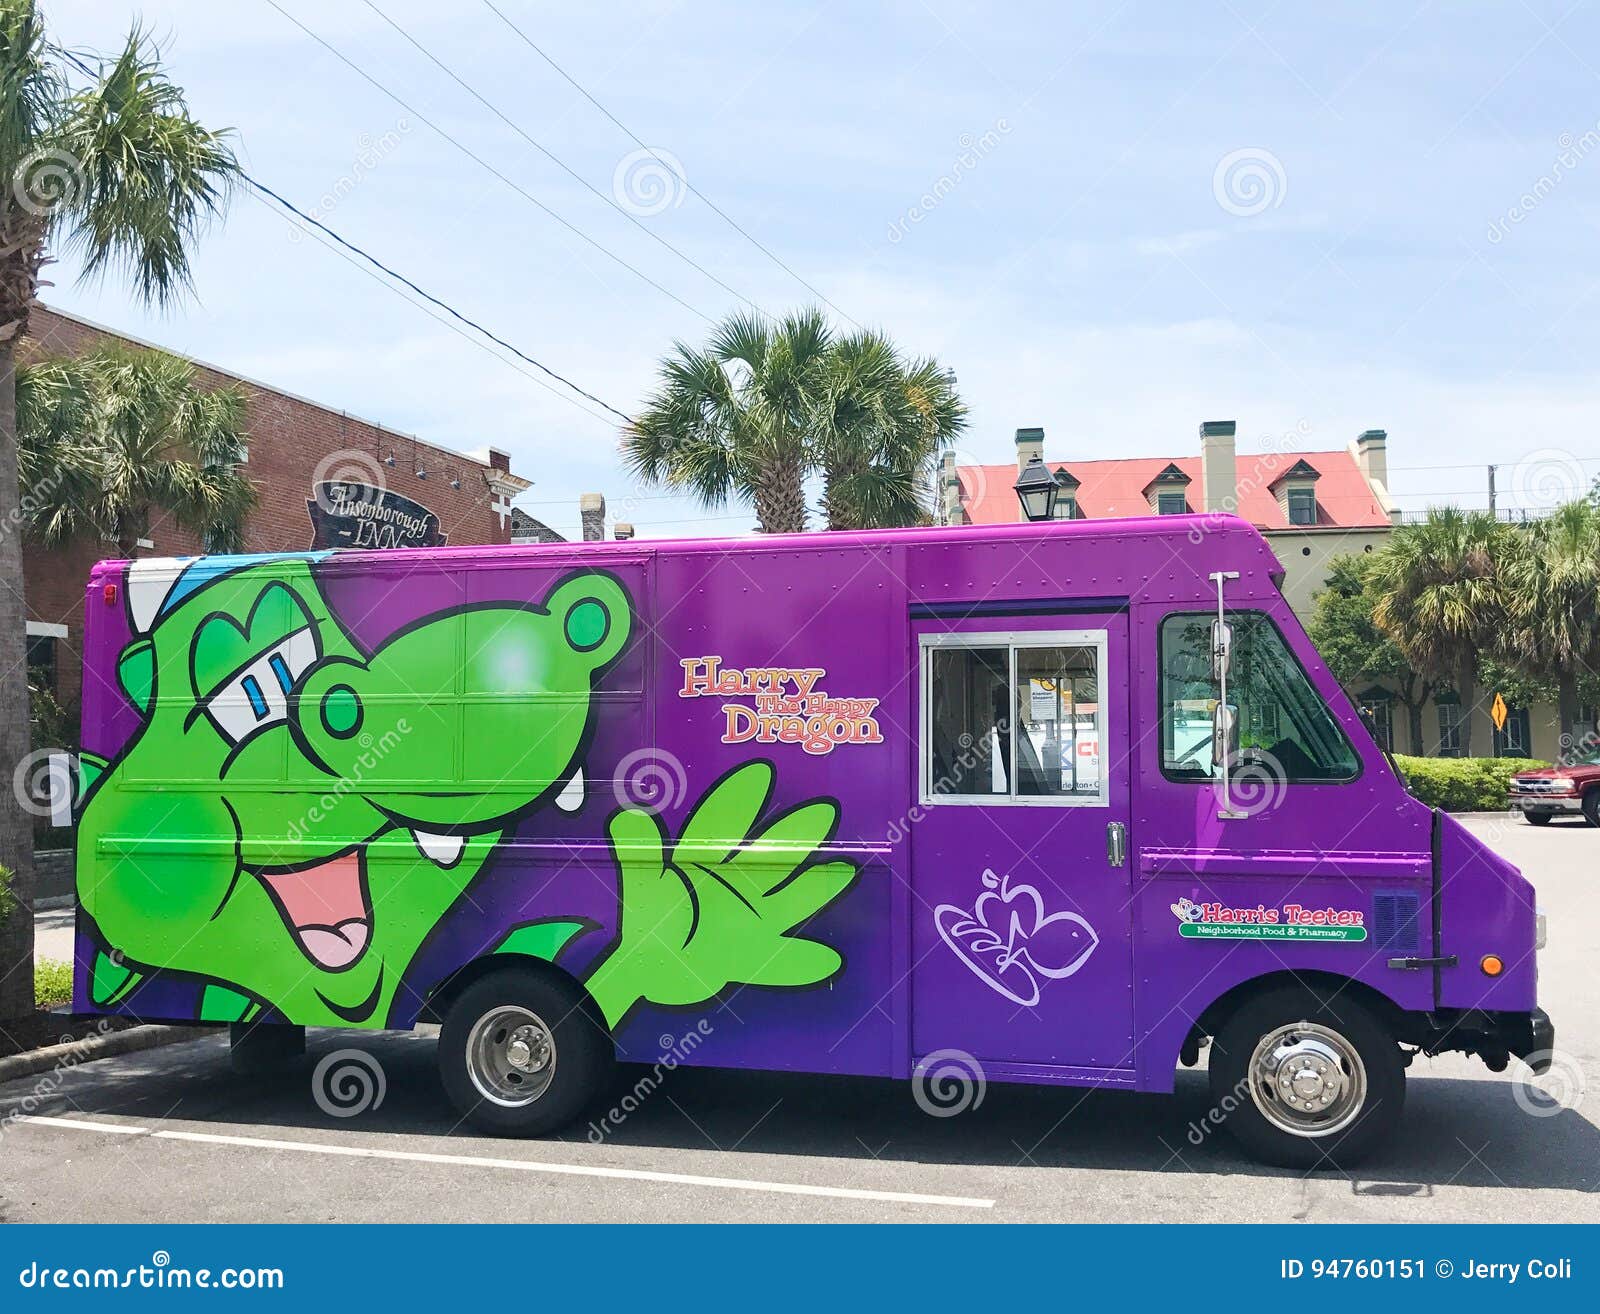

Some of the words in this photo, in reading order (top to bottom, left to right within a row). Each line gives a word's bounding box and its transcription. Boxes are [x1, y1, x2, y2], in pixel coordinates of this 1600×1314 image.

[326, 486, 432, 538] Ansonborough
[680, 656, 825, 701] Harry
[757, 694, 800, 714] The
[804, 694, 878, 719] Happy
[722, 704, 883, 754] Dragon
[1201, 903, 1279, 923] Harris
[1284, 904, 1363, 925] Teeter
[1197, 926, 1260, 936] Neighborhood
[1263, 927, 1285, 936] Food
[1287, 927, 1296, 936] &
[1299, 928, 1347, 938] Pharmacy
